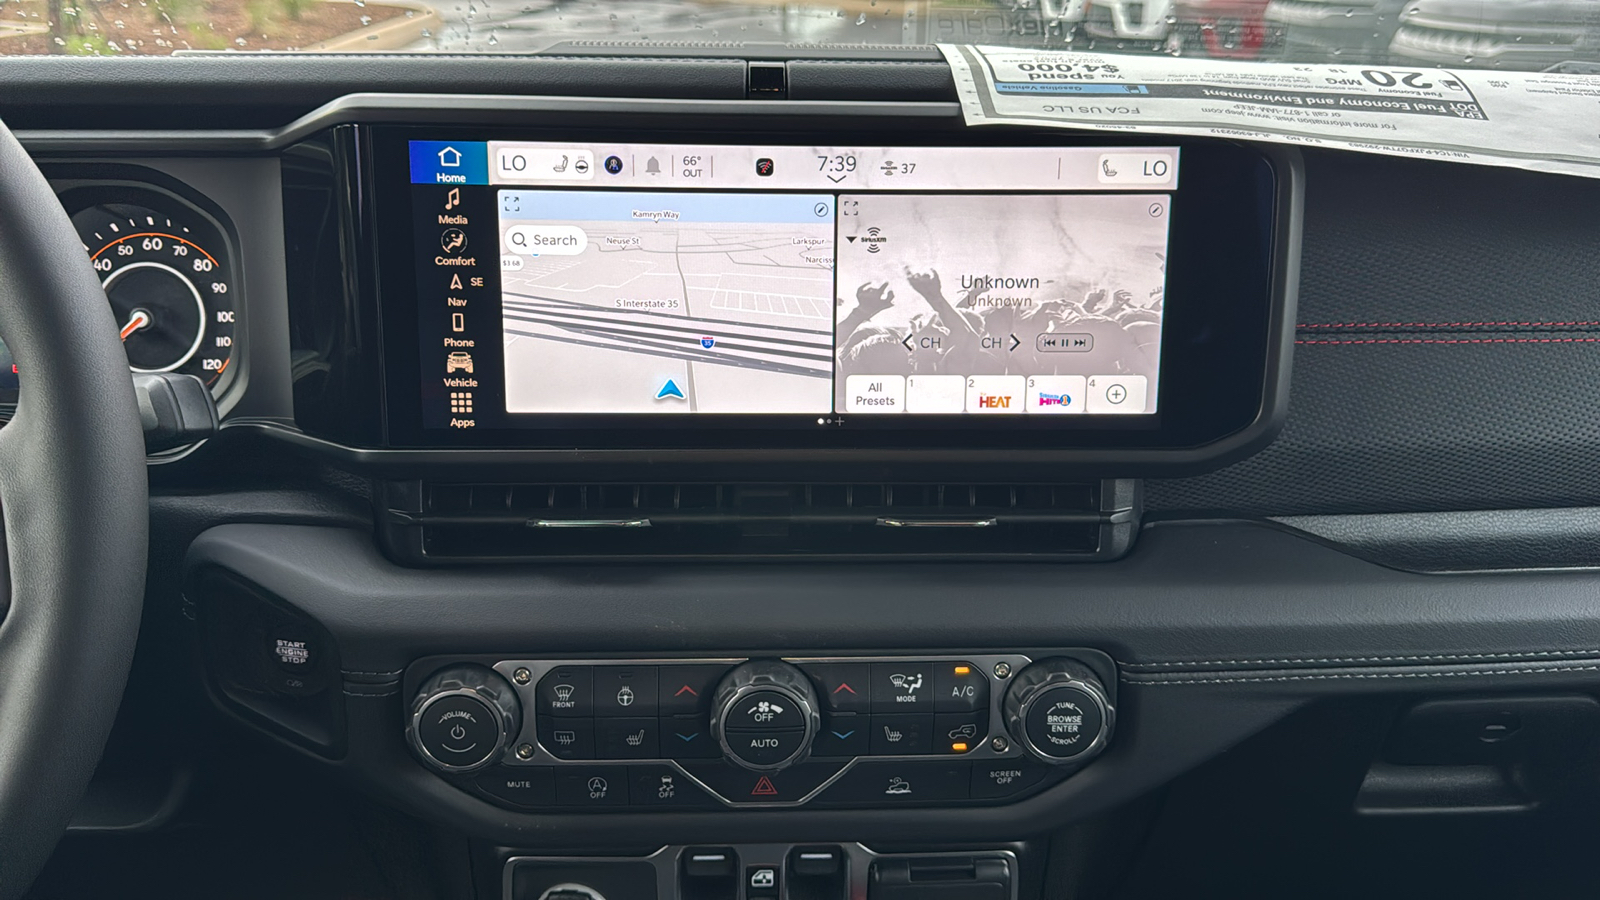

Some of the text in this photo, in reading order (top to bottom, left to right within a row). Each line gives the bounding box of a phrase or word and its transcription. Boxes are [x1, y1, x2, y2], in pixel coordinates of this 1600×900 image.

[1017, 63, 1120, 74] $4,000
[1028, 72, 1095, 81] spend
[1324, 77, 1362, 86] MPG
[1361, 70, 1433, 89] 20
[1378, 88, 1421, 96] Economy
[1202, 89, 1447, 113] Fuel Economy and Environment
[1042, 105, 1141, 115] FCA US LLC
[1448, 102, 1479, 111] DOT
[1312, 111, 1328, 119] call
[1454, 110, 1483, 119] EPA
[1297, 118, 1352, 130] information
[1352, 121, 1379, 129] more
[1380, 122, 1397, 131] For
[502, 155, 527, 171] LO
[682, 155, 701, 166] 66°
[817, 155, 857, 172] 7:39
[682, 169, 703, 178] OUT
[901, 163, 916, 174] 37
[1143, 160, 1168, 177] LO
[436, 172, 466, 183] Home
[438, 214, 468, 225] Media
[632, 209, 680, 221] Kamryn Way
[142, 237, 163, 251] 60
[533, 233, 578, 247] Search
[606, 236, 640, 245] Neuse St
[792, 237, 825, 246] Larkspur
[117, 245, 133, 256] 50
[172, 245, 188, 256] 70
[93, 258, 112, 272] 40
[193, 258, 212, 272] 80
[435, 256, 476, 267] Comfort
[805, 256, 834, 264] Narciss
[470, 277, 484, 287] SE
[961, 274, 1040, 289] Unknown
[211, 282, 227, 294] 90
[447, 297, 467, 307] Nav
[615, 299, 679, 309] S Interstate 35
[967, 294, 1032, 307] Unknown
[215, 336, 232, 347] 110
[444, 337, 475, 348] Phone
[920, 337, 941, 349] CH
[981, 337, 1002, 349] CH
[202, 358, 222, 371] 120
[443, 377, 478, 388] Vehicle
[868, 382, 883, 393] All
[968, 379, 975, 388] 2
[1028, 379, 1035, 388] 3
[1089, 379, 1096, 388] 4
[856, 395, 895, 406] Presets
[979, 396, 1012, 408] HEAT
[450, 417, 475, 429] Apps
[276, 639, 306, 649] START
[275, 647, 309, 657] ENGINE
[282, 656, 307, 664] STOP
[951, 685, 975, 698] A/C
[896, 695, 917, 703] MODE
[552, 701, 575, 709] FRONT
[1055, 701, 1076, 710] TUNE
[442, 711, 472, 723] VOLUME
[754, 713, 774, 722] OFF
[1047, 715, 1082, 723] BROWSE
[1051, 725, 1079, 733] ENTER
[750, 738, 779, 748] AUTO
[1050, 736, 1077, 745] SCROLL
[989, 770, 1022, 779] SCREEN
[507, 780, 531, 789] MUTE
[996, 776, 1013, 785] OFF
[589, 790, 606, 799] OFF
[658, 790, 675, 799] OFF
